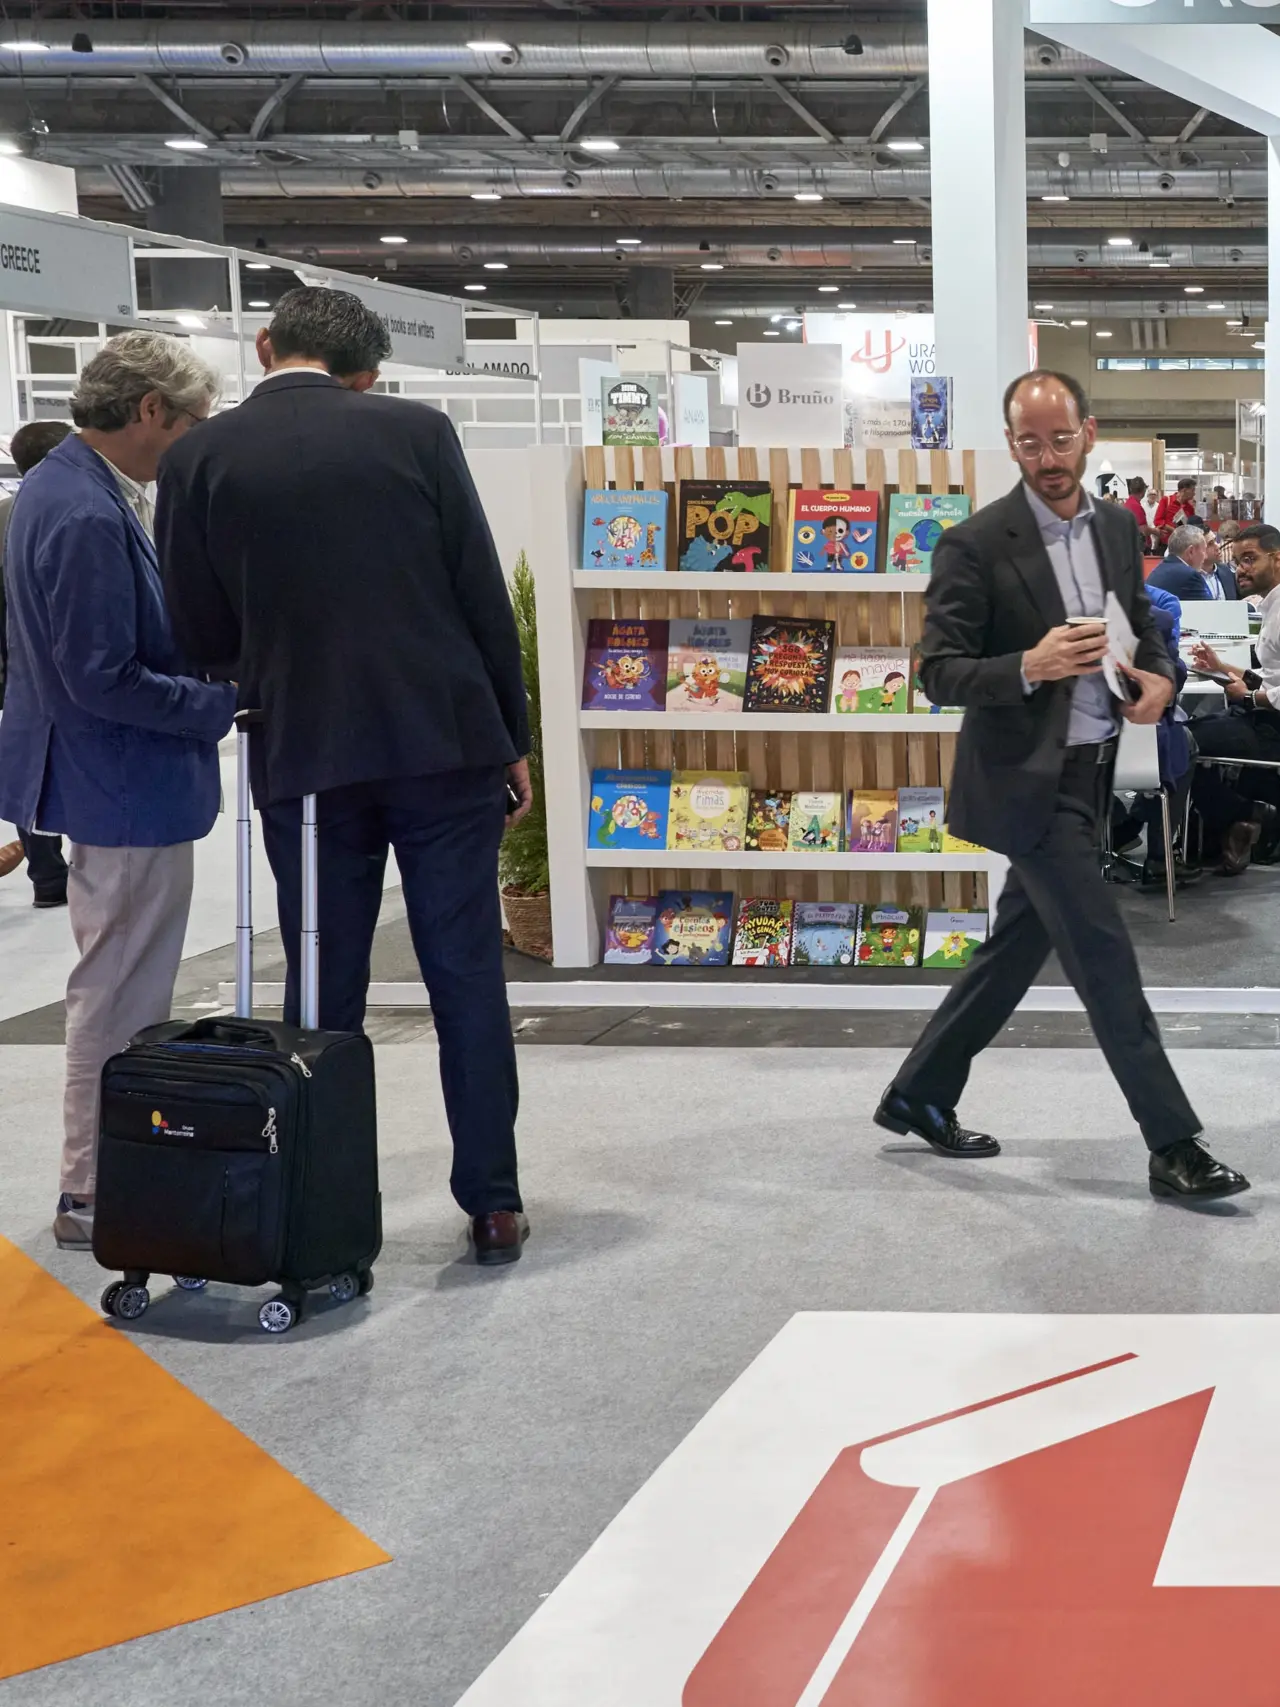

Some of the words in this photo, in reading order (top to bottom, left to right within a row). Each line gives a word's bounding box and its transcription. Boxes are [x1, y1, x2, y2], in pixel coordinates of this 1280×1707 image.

[0, 244, 41, 274] GREECE
[778, 389, 834, 405] Bruño
[839, 505, 871, 513] HUMANO
[915, 497, 942, 510] ABC
[686, 504, 760, 546] POP
[696, 794, 725, 806] rimas
[745, 917, 783, 931] AYUDAR
